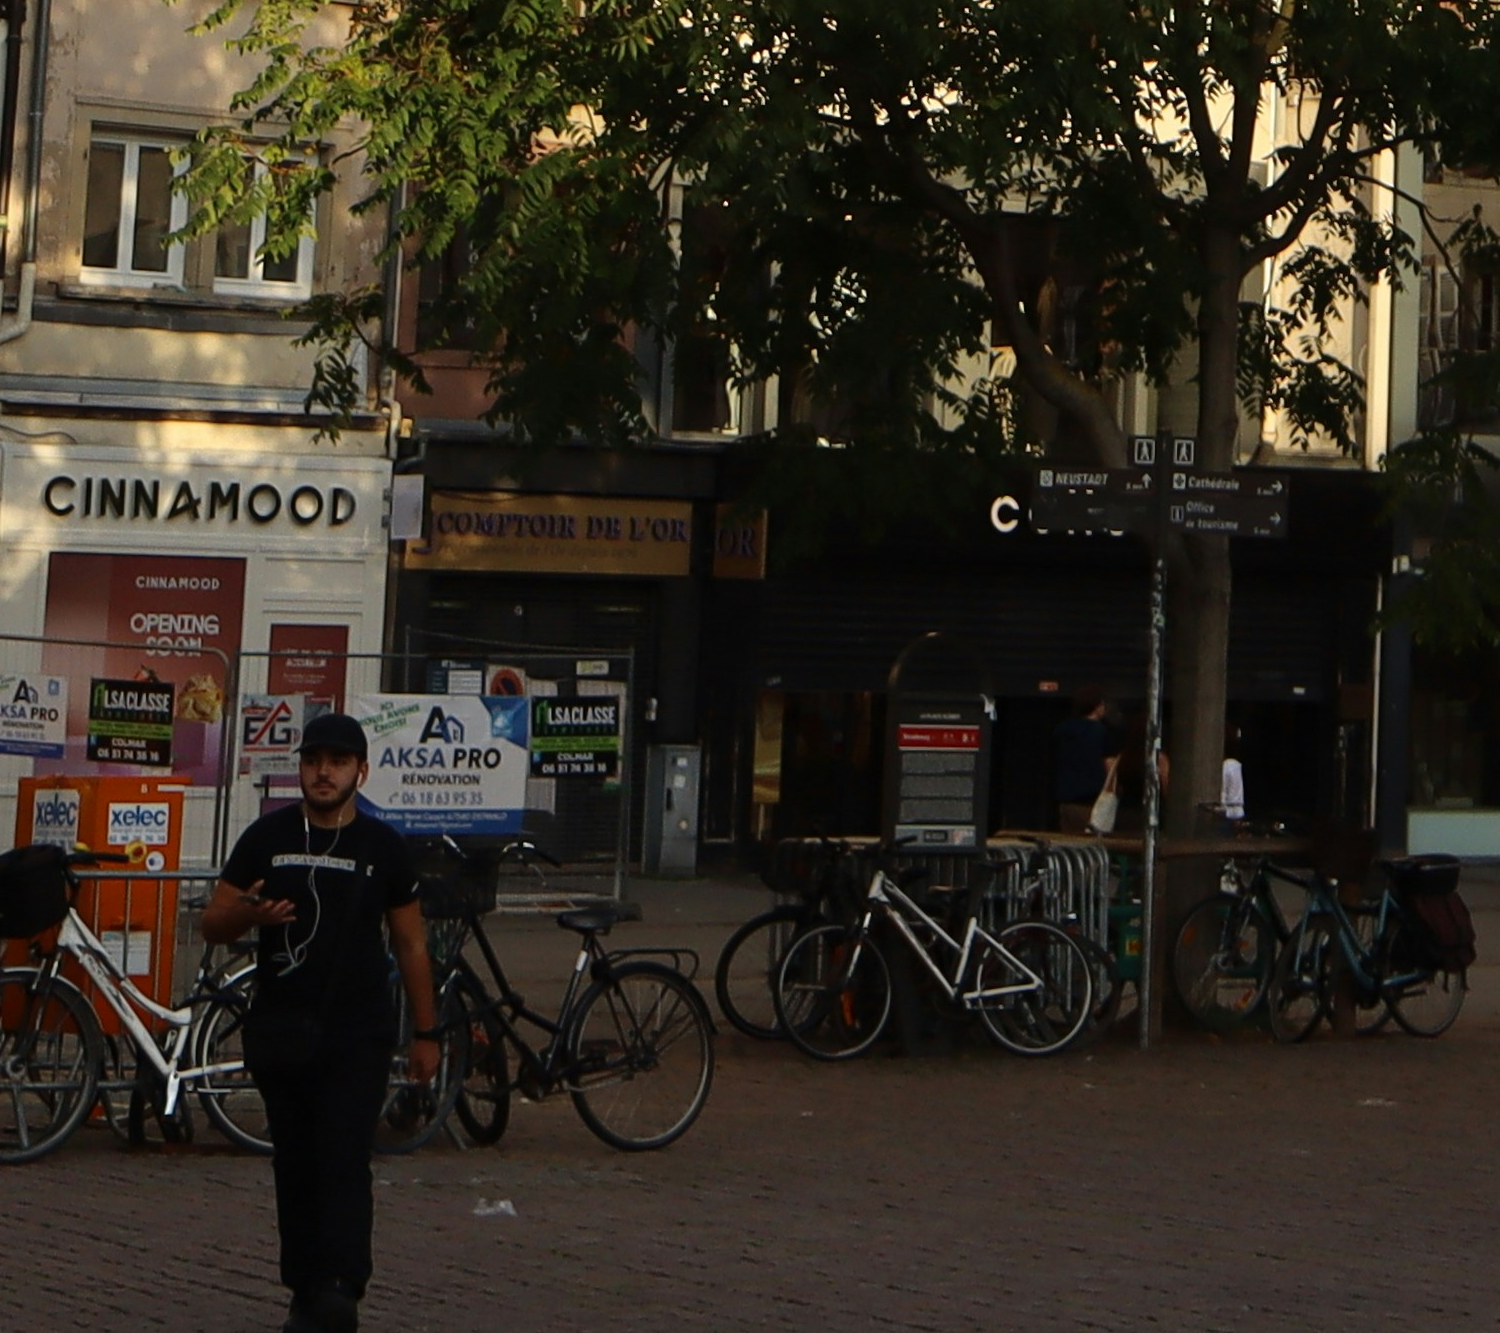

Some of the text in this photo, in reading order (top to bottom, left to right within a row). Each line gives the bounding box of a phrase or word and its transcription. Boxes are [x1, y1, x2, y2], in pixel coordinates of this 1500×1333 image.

[1055, 473, 1108, 486] NEUSTADT
[1187, 475, 1240, 491] Cathédrale
[44, 475, 356, 526] CINNAMOOD
[1185, 500, 1215, 514] Office
[437, 511, 688, 543] COMPTOIR DE L'OR
[1197, 518, 1239, 531] tourisme
[135, 576, 220, 592] CINNAMOOD
[130, 613, 220, 635] OPENING
[30, 706, 59, 723] PRO
[379, 747, 501, 769] AKSA PRO
[402, 771, 481, 786] RÉNOVATION
[402, 792, 416, 806] 06
[420, 792, 434, 806] 18
[435, 792, 450, 806] 63
[470, 792, 484, 806] 35
[35, 792, 78, 826] xelec
[111, 805, 167, 827] xelec
